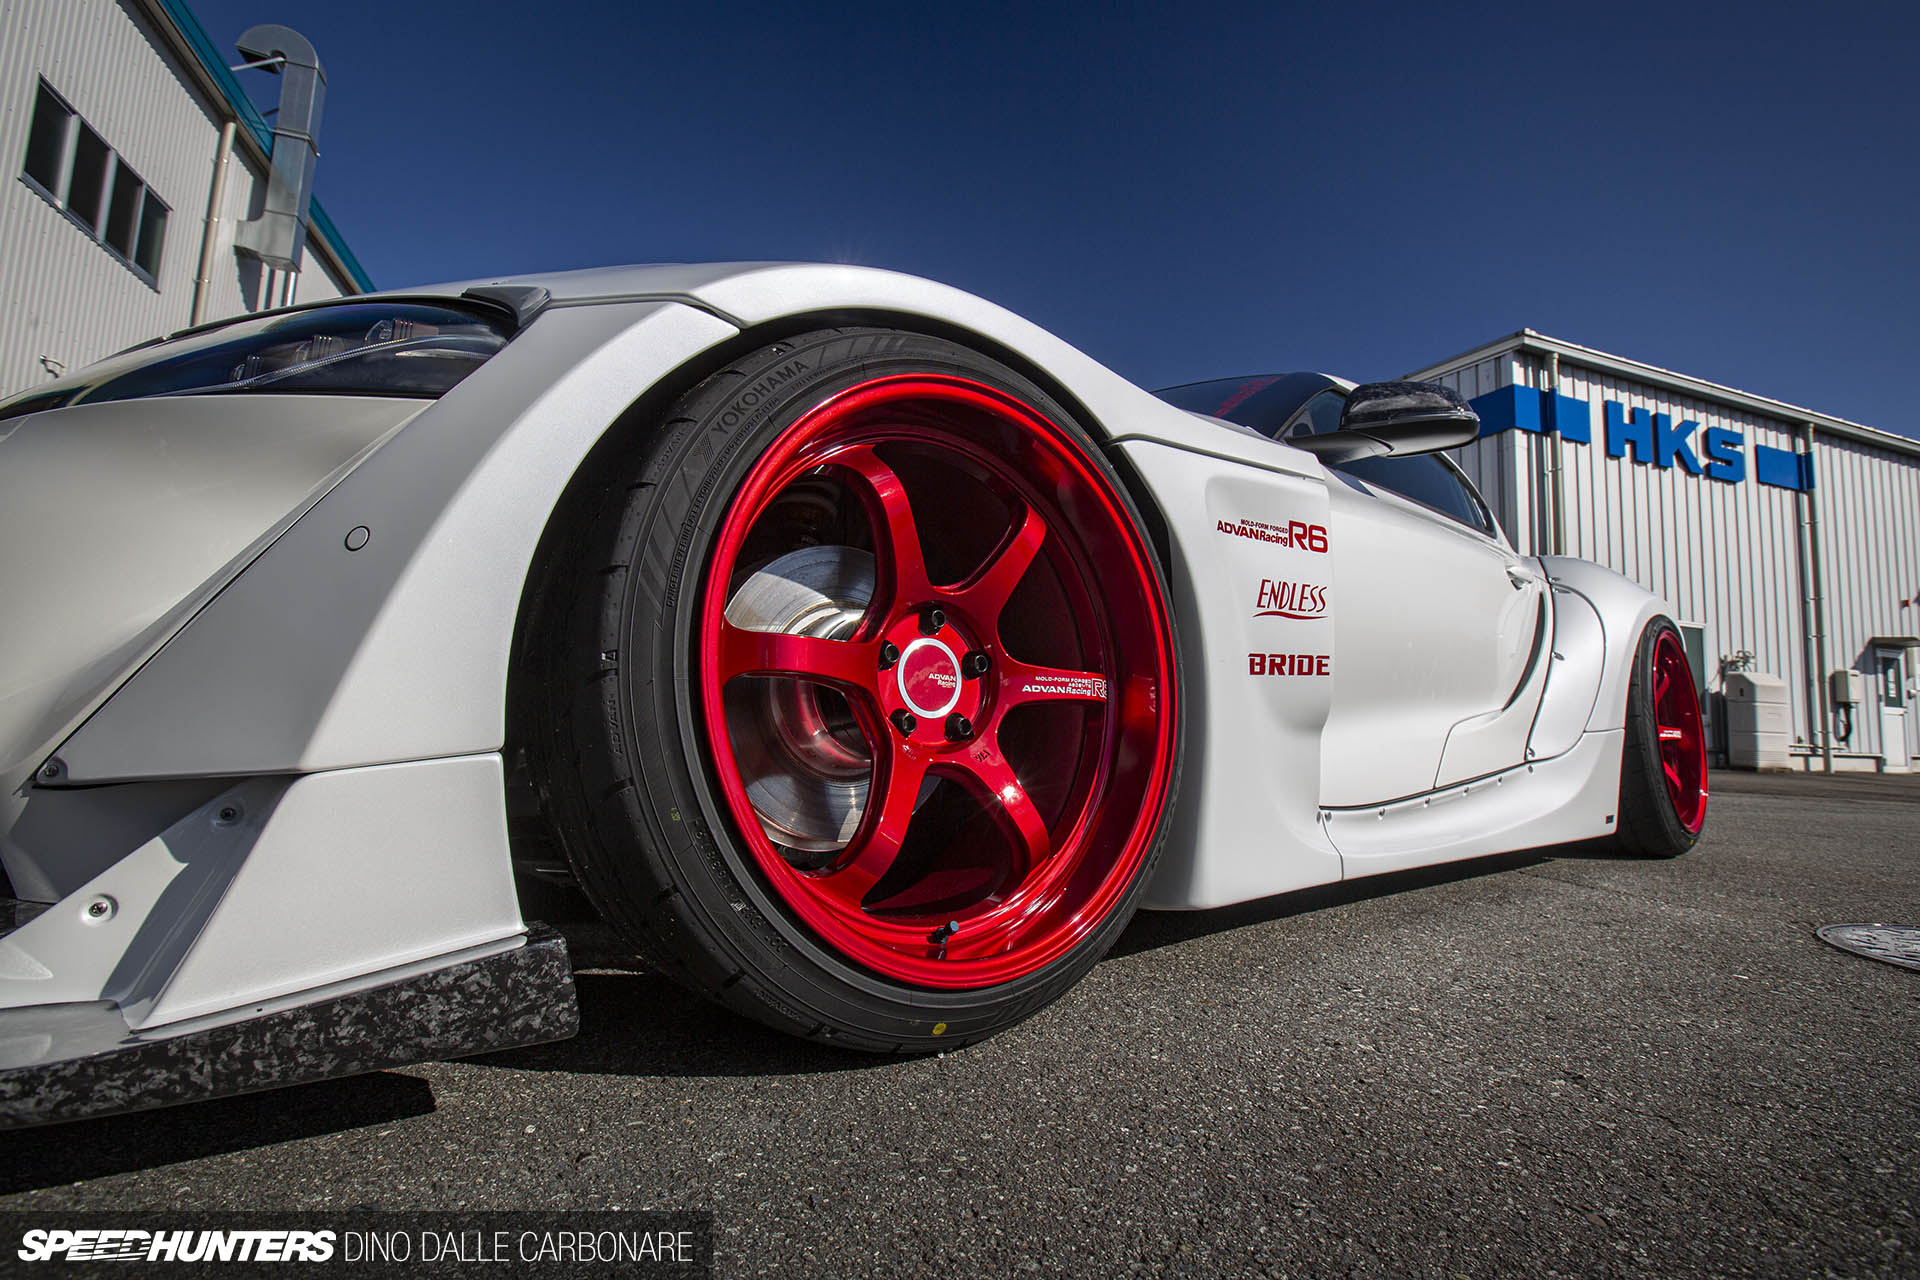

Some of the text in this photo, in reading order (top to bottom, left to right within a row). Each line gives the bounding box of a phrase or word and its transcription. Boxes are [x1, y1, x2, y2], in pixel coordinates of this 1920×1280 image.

[711, 359, 810, 436] YOKOHAMA
[1603, 399, 1746, 483] HKS
[1288, 520, 1328, 553] R6
[1256, 578, 1328, 613] ENDLESS
[928, 673, 956, 681] ADVAN
[1248, 653, 1330, 676] BRIDE
